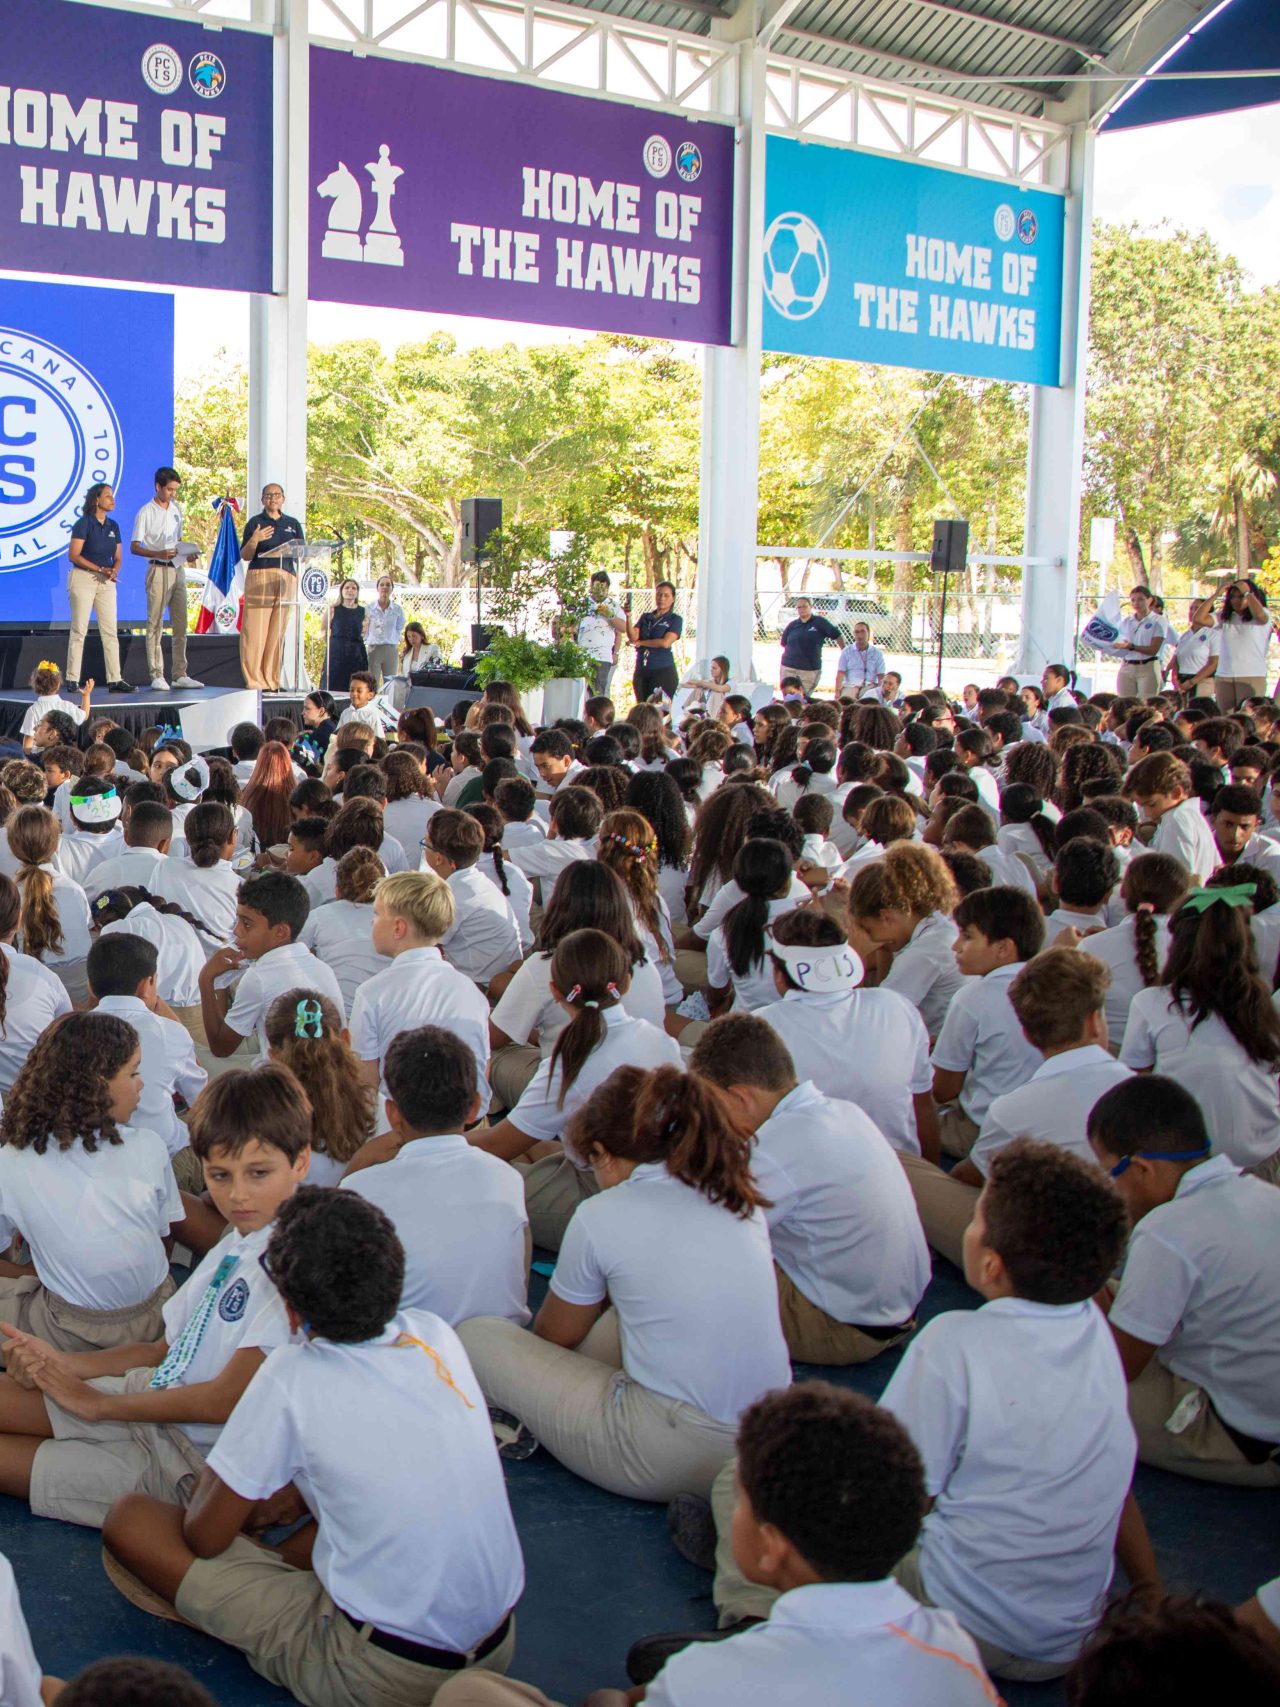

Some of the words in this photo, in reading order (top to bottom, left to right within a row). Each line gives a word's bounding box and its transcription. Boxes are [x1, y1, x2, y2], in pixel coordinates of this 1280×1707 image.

[154, 57, 170, 69] PC
[160, 108, 227, 170] OF
[18, 164, 227, 245] HAWKS
[521, 166, 641, 235] HOME
[654, 190, 702, 244] OF
[449, 223, 541, 285] THE
[554, 236, 702, 305] HAWKS
[905, 234, 993, 295] HOME
[1002, 252, 1037, 296] OF
[854, 282, 919, 334] THE
[929, 294, 1036, 351] HAWKS
[59, 429, 110, 534] SCOOL
